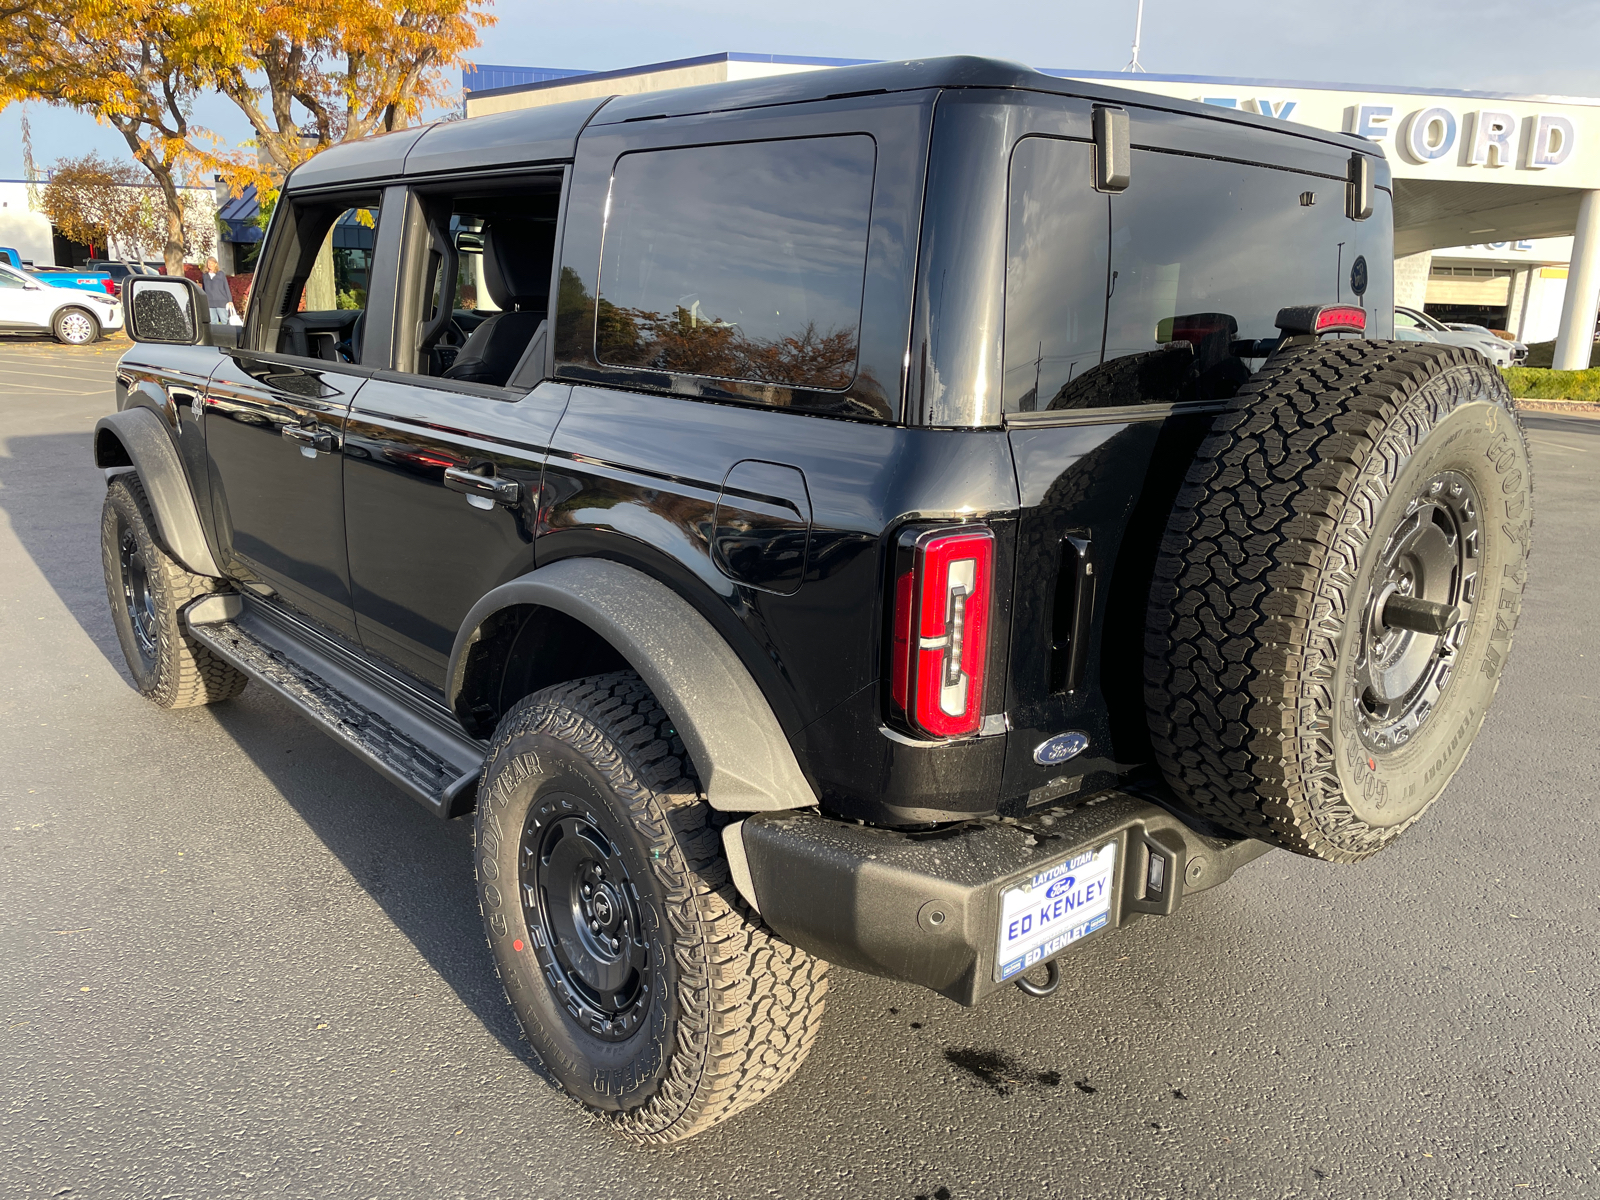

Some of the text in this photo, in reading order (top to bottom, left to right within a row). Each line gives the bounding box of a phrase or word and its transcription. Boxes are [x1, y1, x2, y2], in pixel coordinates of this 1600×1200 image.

[1357, 104, 1576, 168] FORD
[1480, 432, 1529, 680] GOODYEAR
[483, 750, 544, 938] GOODYEAR
[1032, 851, 1093, 887] LAYTON, UTAH
[1008, 913, 1033, 941] ED
[1040, 877, 1107, 926] KENLEY
[1049, 877, 1073, 898] Ford
[1024, 948, 1042, 966] ED
[1043, 922, 1089, 957] KENLEY
